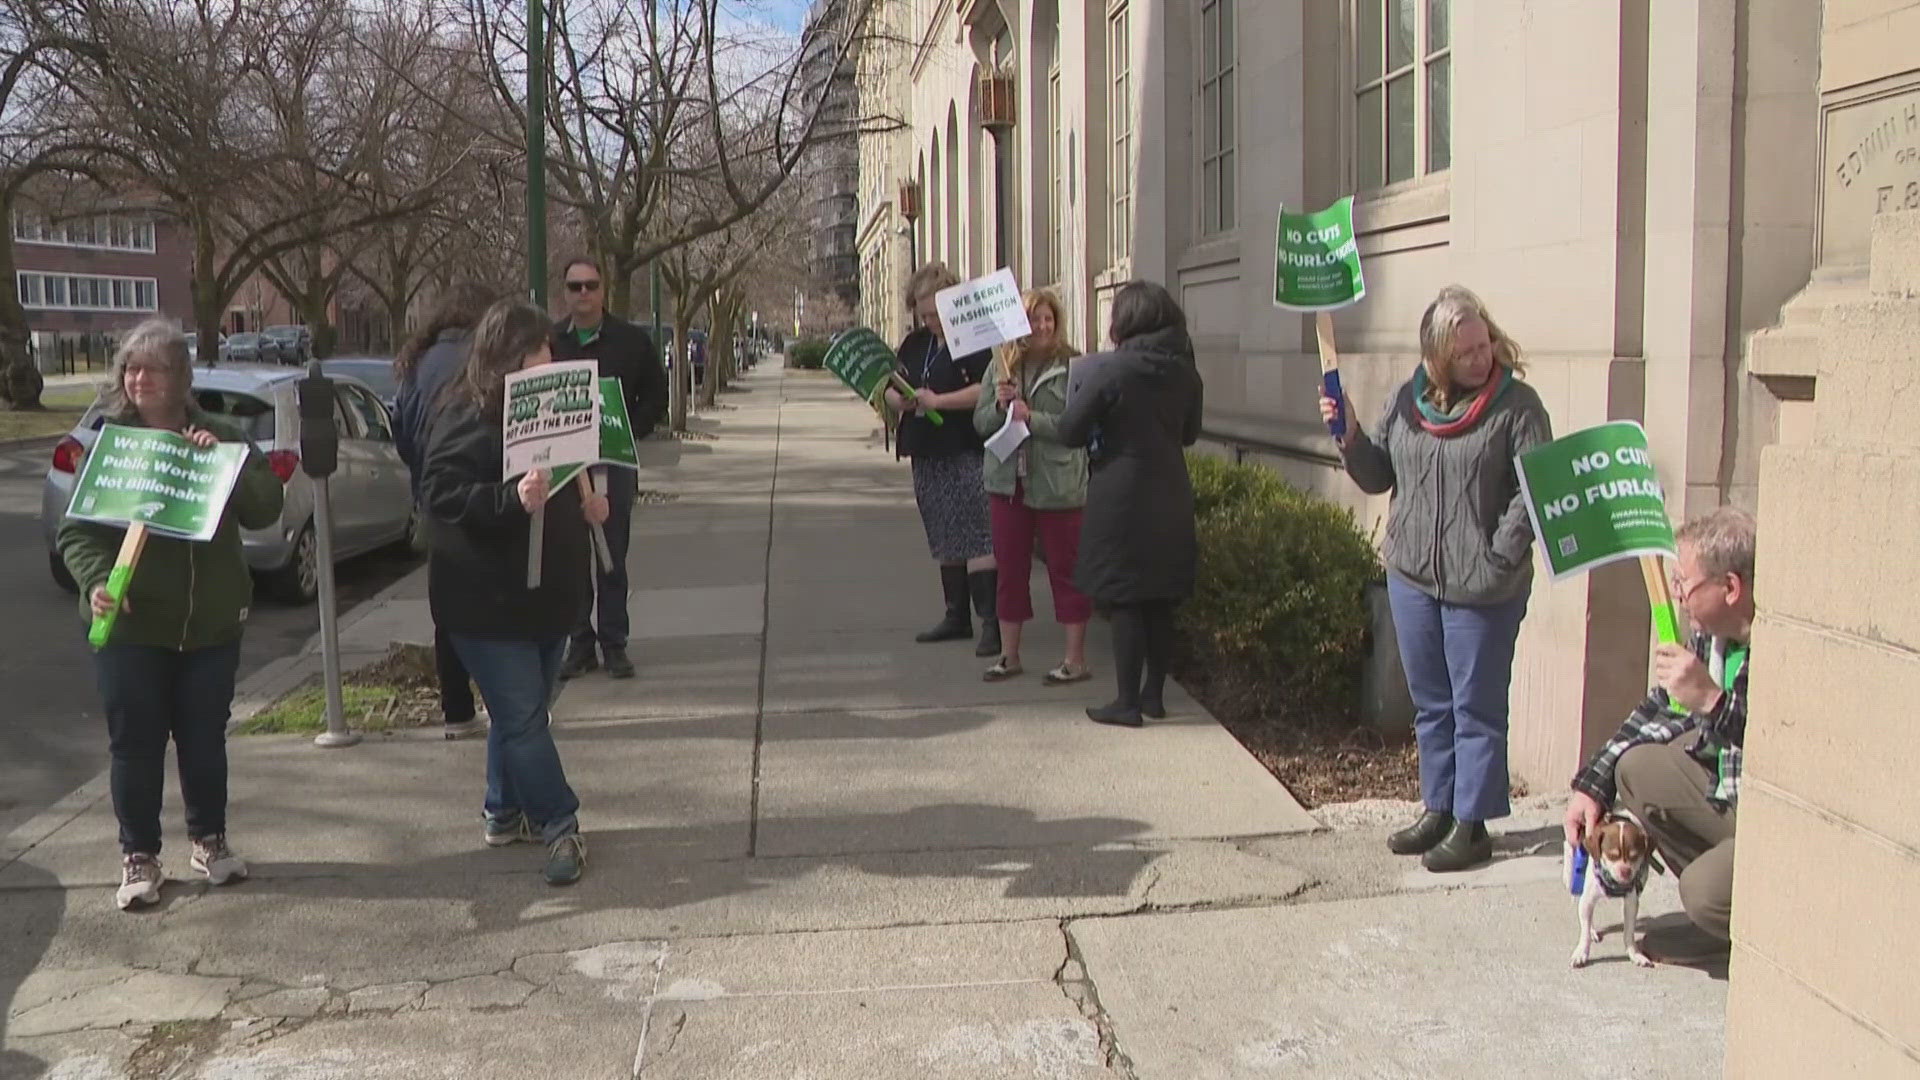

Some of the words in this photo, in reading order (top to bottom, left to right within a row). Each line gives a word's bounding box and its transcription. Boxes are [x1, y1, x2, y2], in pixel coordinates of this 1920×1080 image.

[1286, 227, 1302, 244] NO
[952, 293, 971, 308] WE
[973, 283, 1005, 301] SERVE
[950, 296, 1017, 327] WASHINGTON
[510, 369, 592, 399] WASHINGTON
[507, 395, 540, 427] FOR
[552, 387, 593, 413] ALL
[520, 421, 540, 435] JUST
[543, 416, 560, 430] THE
[564, 412, 592, 427] RICH
[114, 435, 140, 450] We
[141, 437, 190, 459] Stand
[102, 454, 150, 471] Public
[154, 460, 214, 483] Worker
[1571, 451, 1610, 478] NO
[94, 474, 122, 489] Not
[125, 475, 209, 503] Billionaire
[1543, 493, 1579, 521] NO
